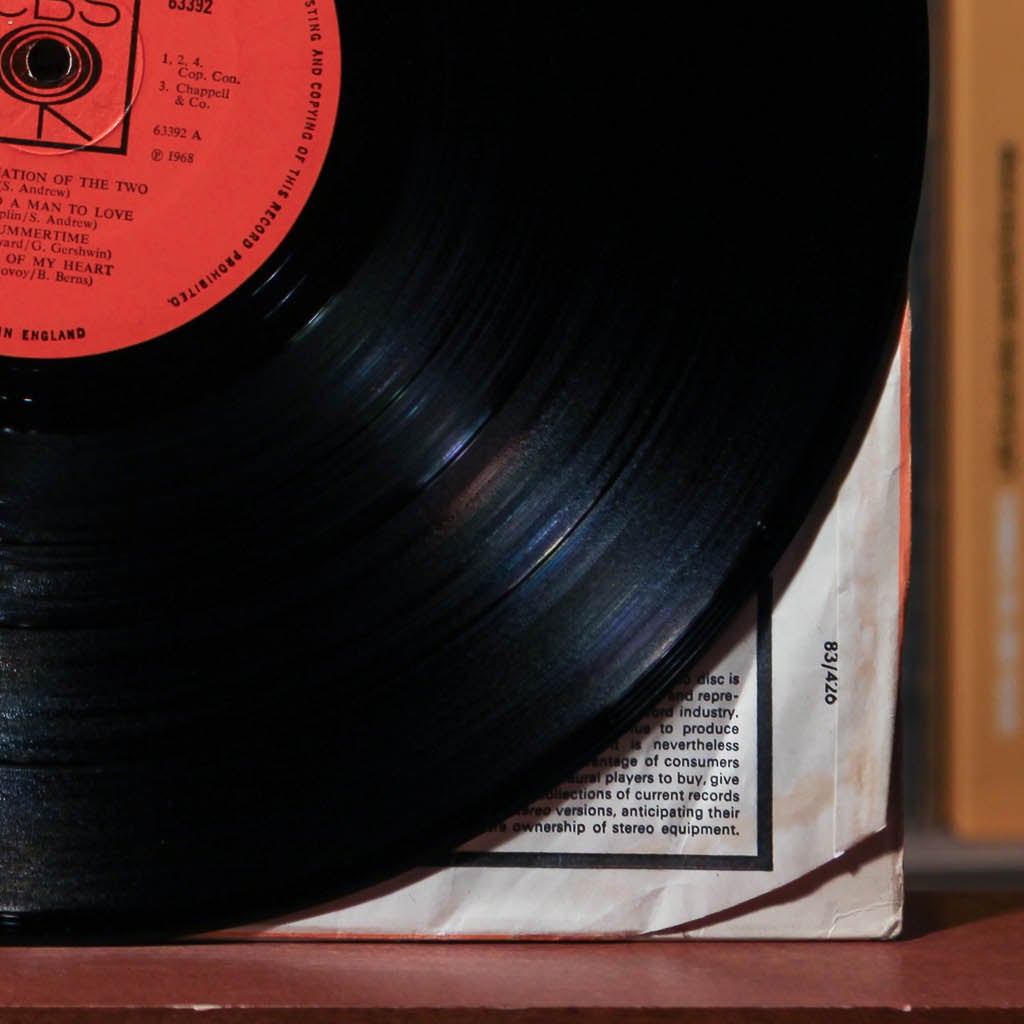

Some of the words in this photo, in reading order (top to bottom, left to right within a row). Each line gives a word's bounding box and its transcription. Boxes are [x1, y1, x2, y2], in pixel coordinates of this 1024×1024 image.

[311, 49, 323, 76] AND
[178, 67, 207, 81] Cop.
[211, 71, 241, 85] Con.
[176, 83, 230, 99] Chappell
[301, 82, 323, 141] COPYING
[153, 125, 187, 138] 63392
[19, 184, 71, 198] Andrew)
[53, 174, 73, 185] OF
[80, 177, 110, 190] THE
[115, 181, 149, 195] TWO
[277, 169, 300, 200] THIS
[28, 199, 63, 213] MAN
[69, 204, 88, 216] TO
[95, 207, 134, 222] LOVE
[46, 215, 97, 231] Andrew)
[242, 201, 282, 249] RECORD
[51, 242, 112, 261] Gershwin)
[6, 253, 26, 265] OF
[33, 256, 56, 269] MY
[64, 260, 115, 276] HEART
[167, 249, 243, 308] PROHIBITED.
[22, 327, 86, 342] ENGLAND
[821, 641, 838, 705] 83/426
[698, 692, 739, 704] repre-
[680, 706, 739, 720] industry.
[660, 724, 673, 735] to
[683, 724, 739, 736] produce
[654, 739, 739, 751] nevertheless
[645, 755, 658, 767] of
[665, 757, 739, 768] consumers
[605, 772, 654, 785] players
[659, 773, 672, 784] to
[677, 773, 706, 787] buy,
[711, 773, 739, 787] give
[617, 789, 630, 800] of
[635, 790, 684, 801] current
[689, 790, 740, 802] records
[556, 804, 617, 818] versions,
[622, 805, 703, 820] anticipating
[708, 806, 740, 819] their
[513, 820, 585, 835] ownership
[593, 821, 606, 833] of
[613, 823, 654, 834] stereo
[662, 822, 739, 836] equipment.
